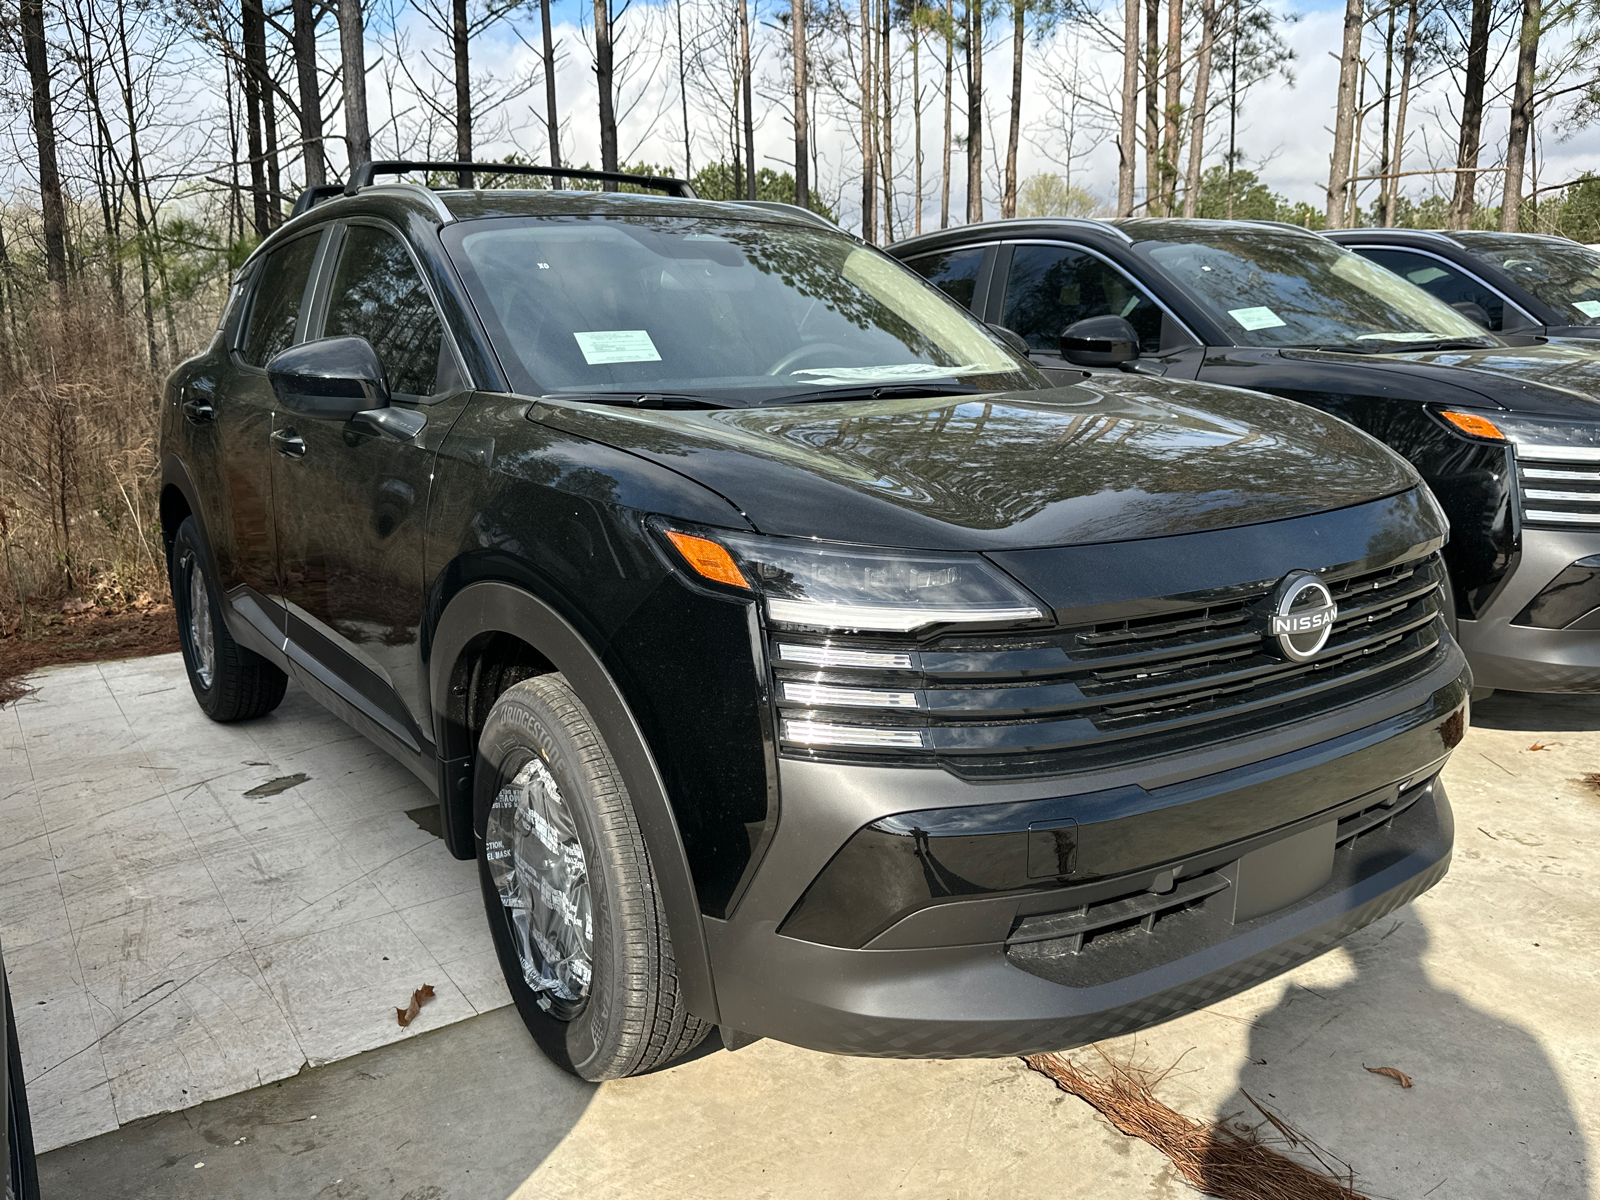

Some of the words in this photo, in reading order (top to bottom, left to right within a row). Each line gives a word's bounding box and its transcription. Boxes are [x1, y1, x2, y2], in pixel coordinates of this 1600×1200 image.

[1277, 608, 1338, 632] NISSAN
[500, 704, 567, 774] BRIDGESTONE
[495, 849, 511, 860] MASK
